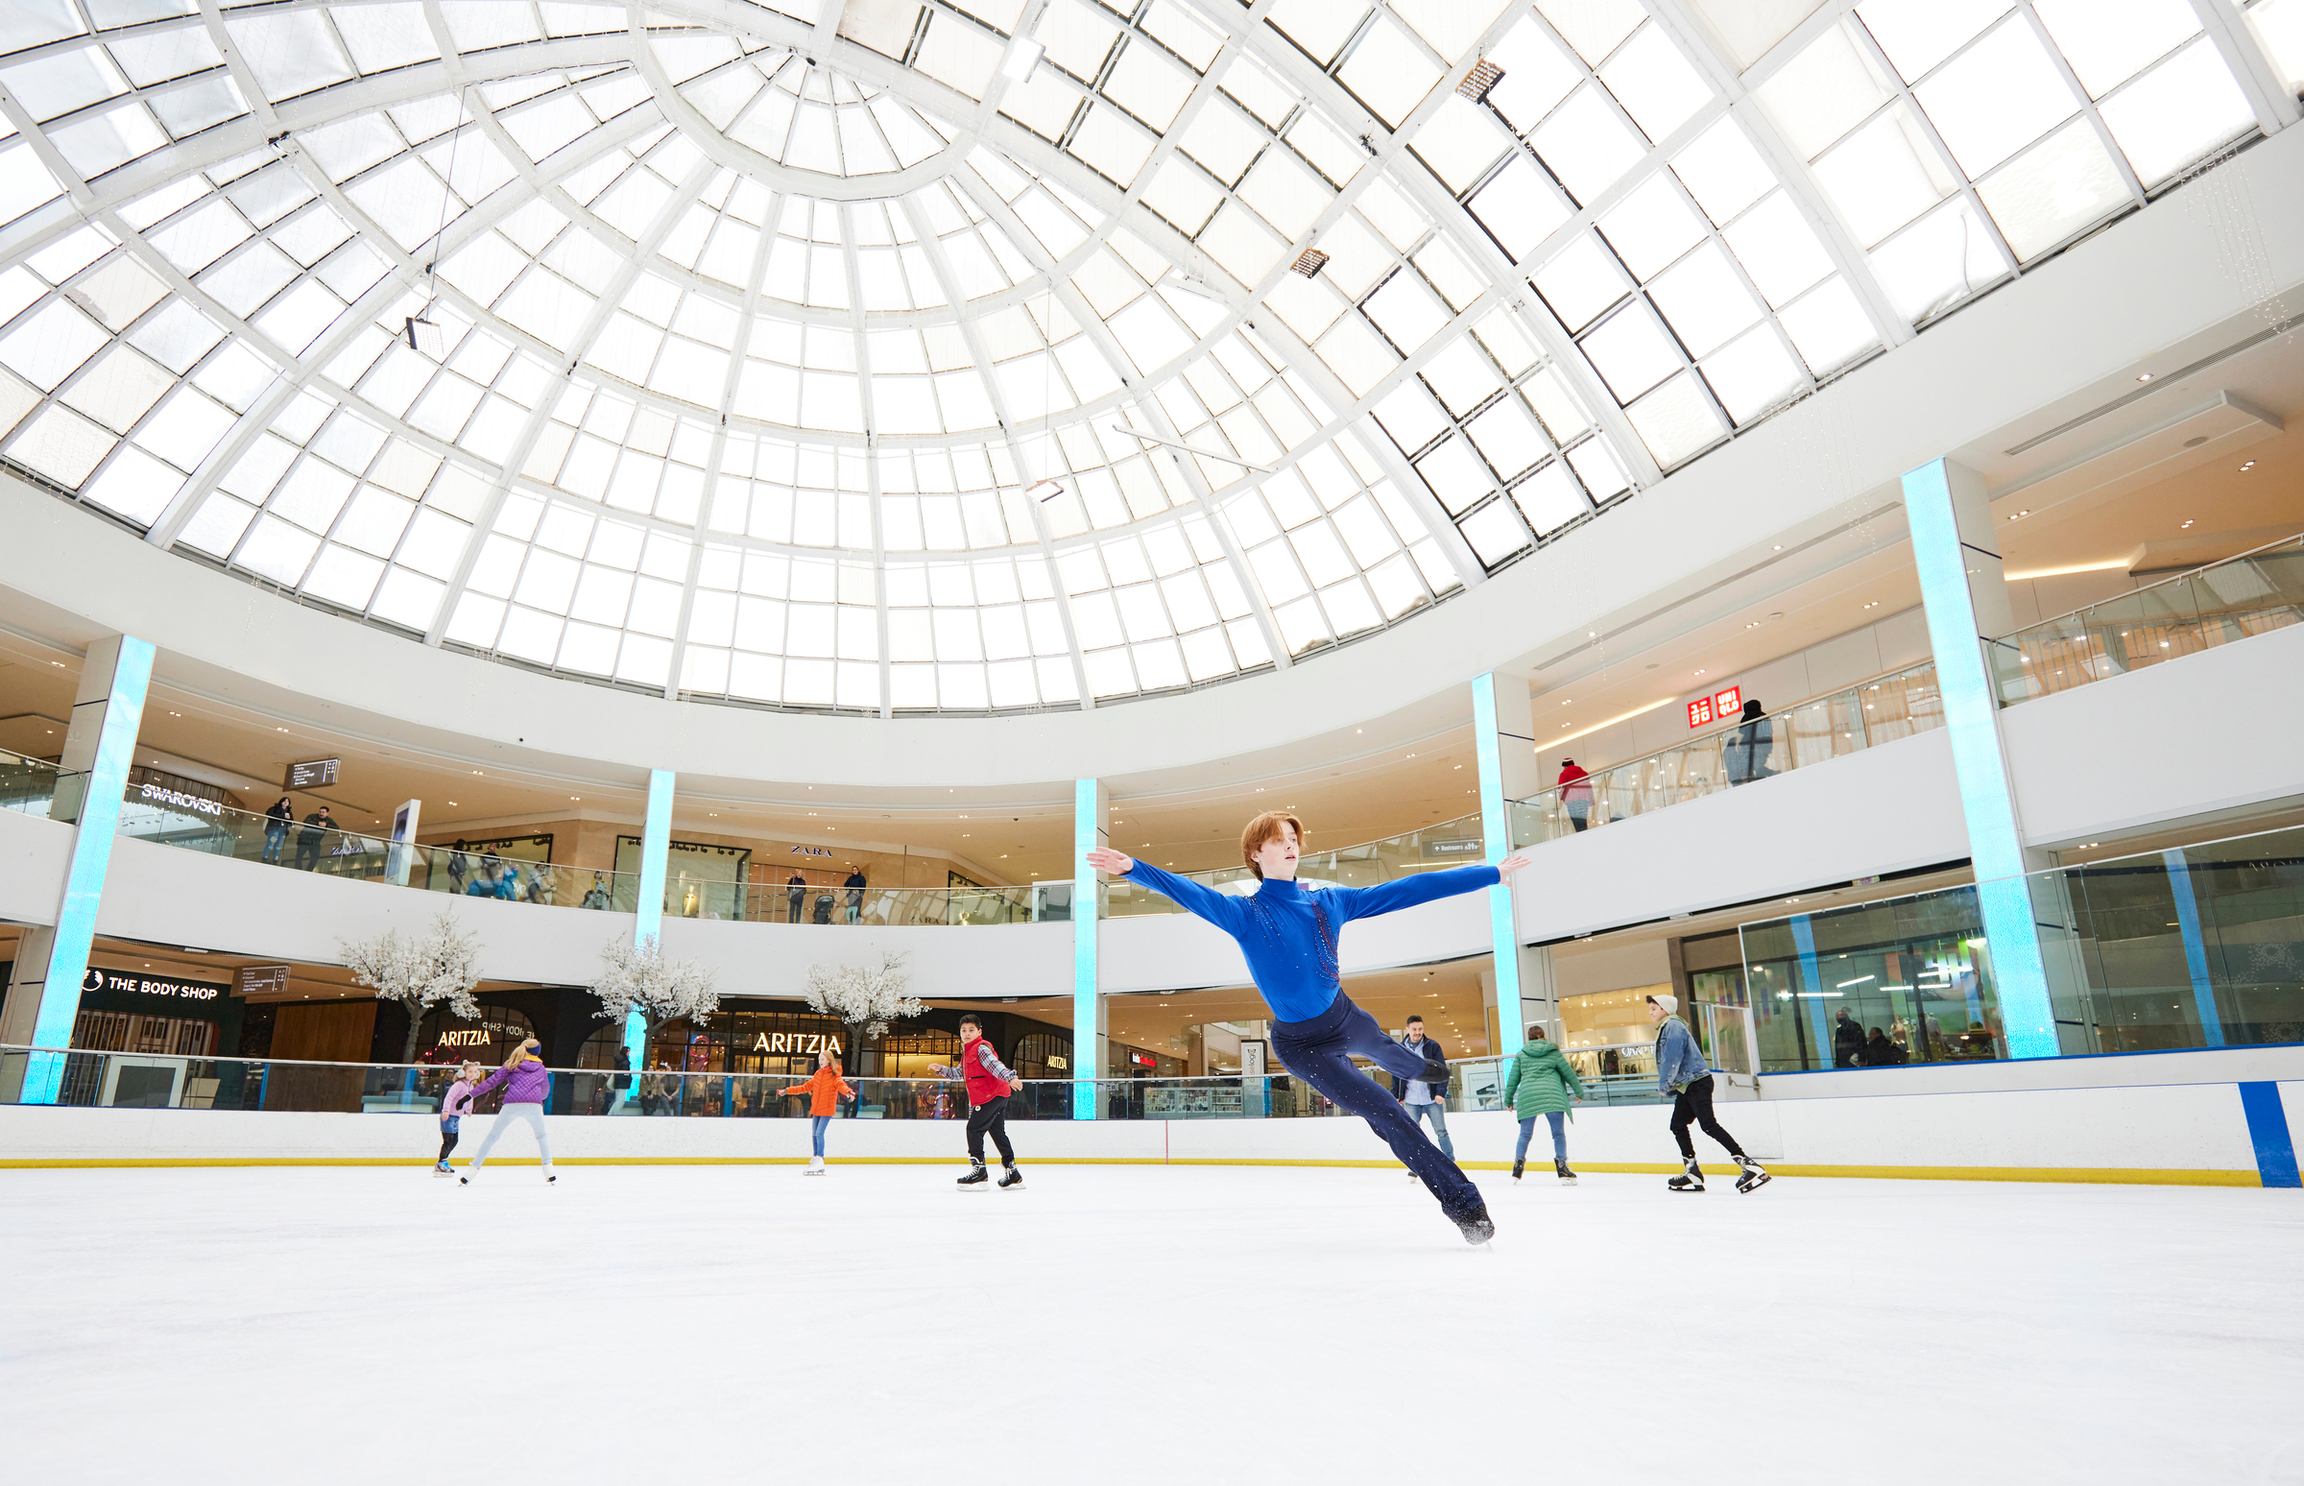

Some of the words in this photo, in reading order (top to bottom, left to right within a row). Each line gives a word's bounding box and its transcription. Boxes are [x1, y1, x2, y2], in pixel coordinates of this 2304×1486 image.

[1717, 690, 1737, 705] UNI
[1718, 700, 1740, 716] QLO
[141, 783, 222, 816] SWAROVSKI
[791, 845, 832, 857] ZARA
[109, 976, 138, 992] THE
[140, 980, 180, 997] BODY
[180, 985, 218, 1001] SHOP
[438, 1029, 491, 1047] ARITZIA
[752, 1031, 842, 1055] ARITZIA
